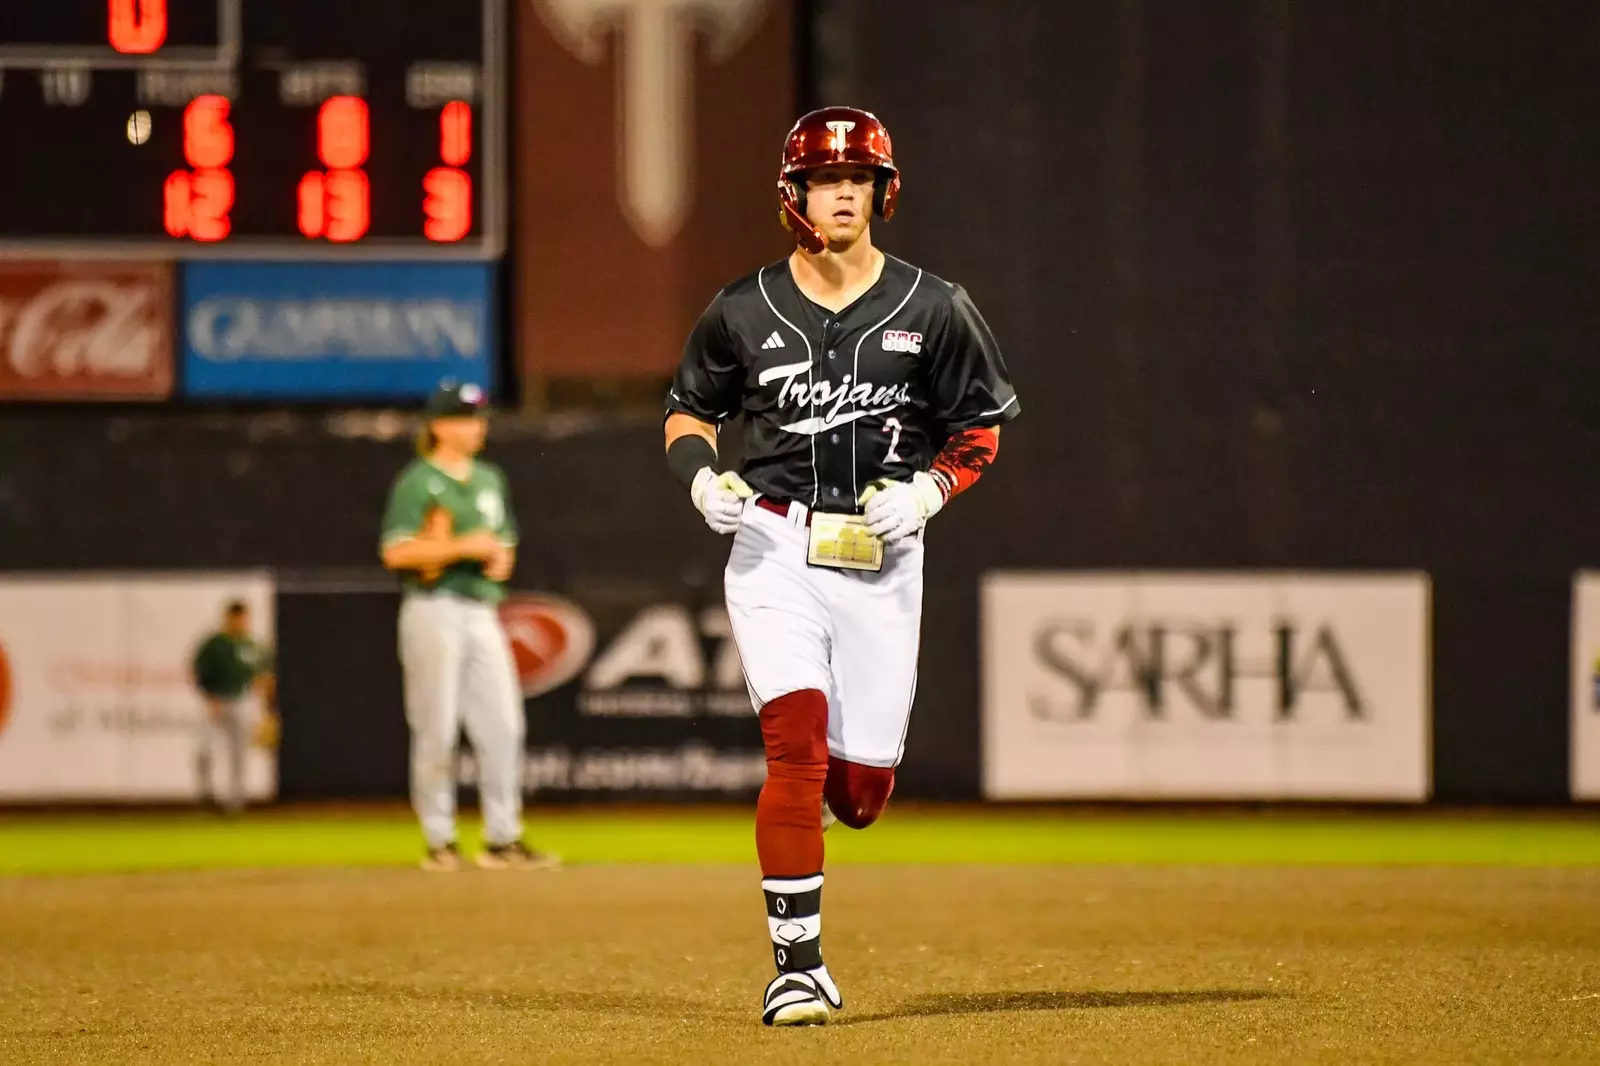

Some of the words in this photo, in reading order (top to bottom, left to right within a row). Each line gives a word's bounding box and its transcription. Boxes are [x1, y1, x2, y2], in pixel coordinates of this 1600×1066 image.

[184, 95, 234, 168] 6
[441, 101, 471, 166] 1
[164, 167, 234, 241] 12
[298, 167, 369, 241] 13
[423, 167, 471, 241] 3
[758, 360, 911, 424] Trojans
[882, 417, 903, 464] 2
